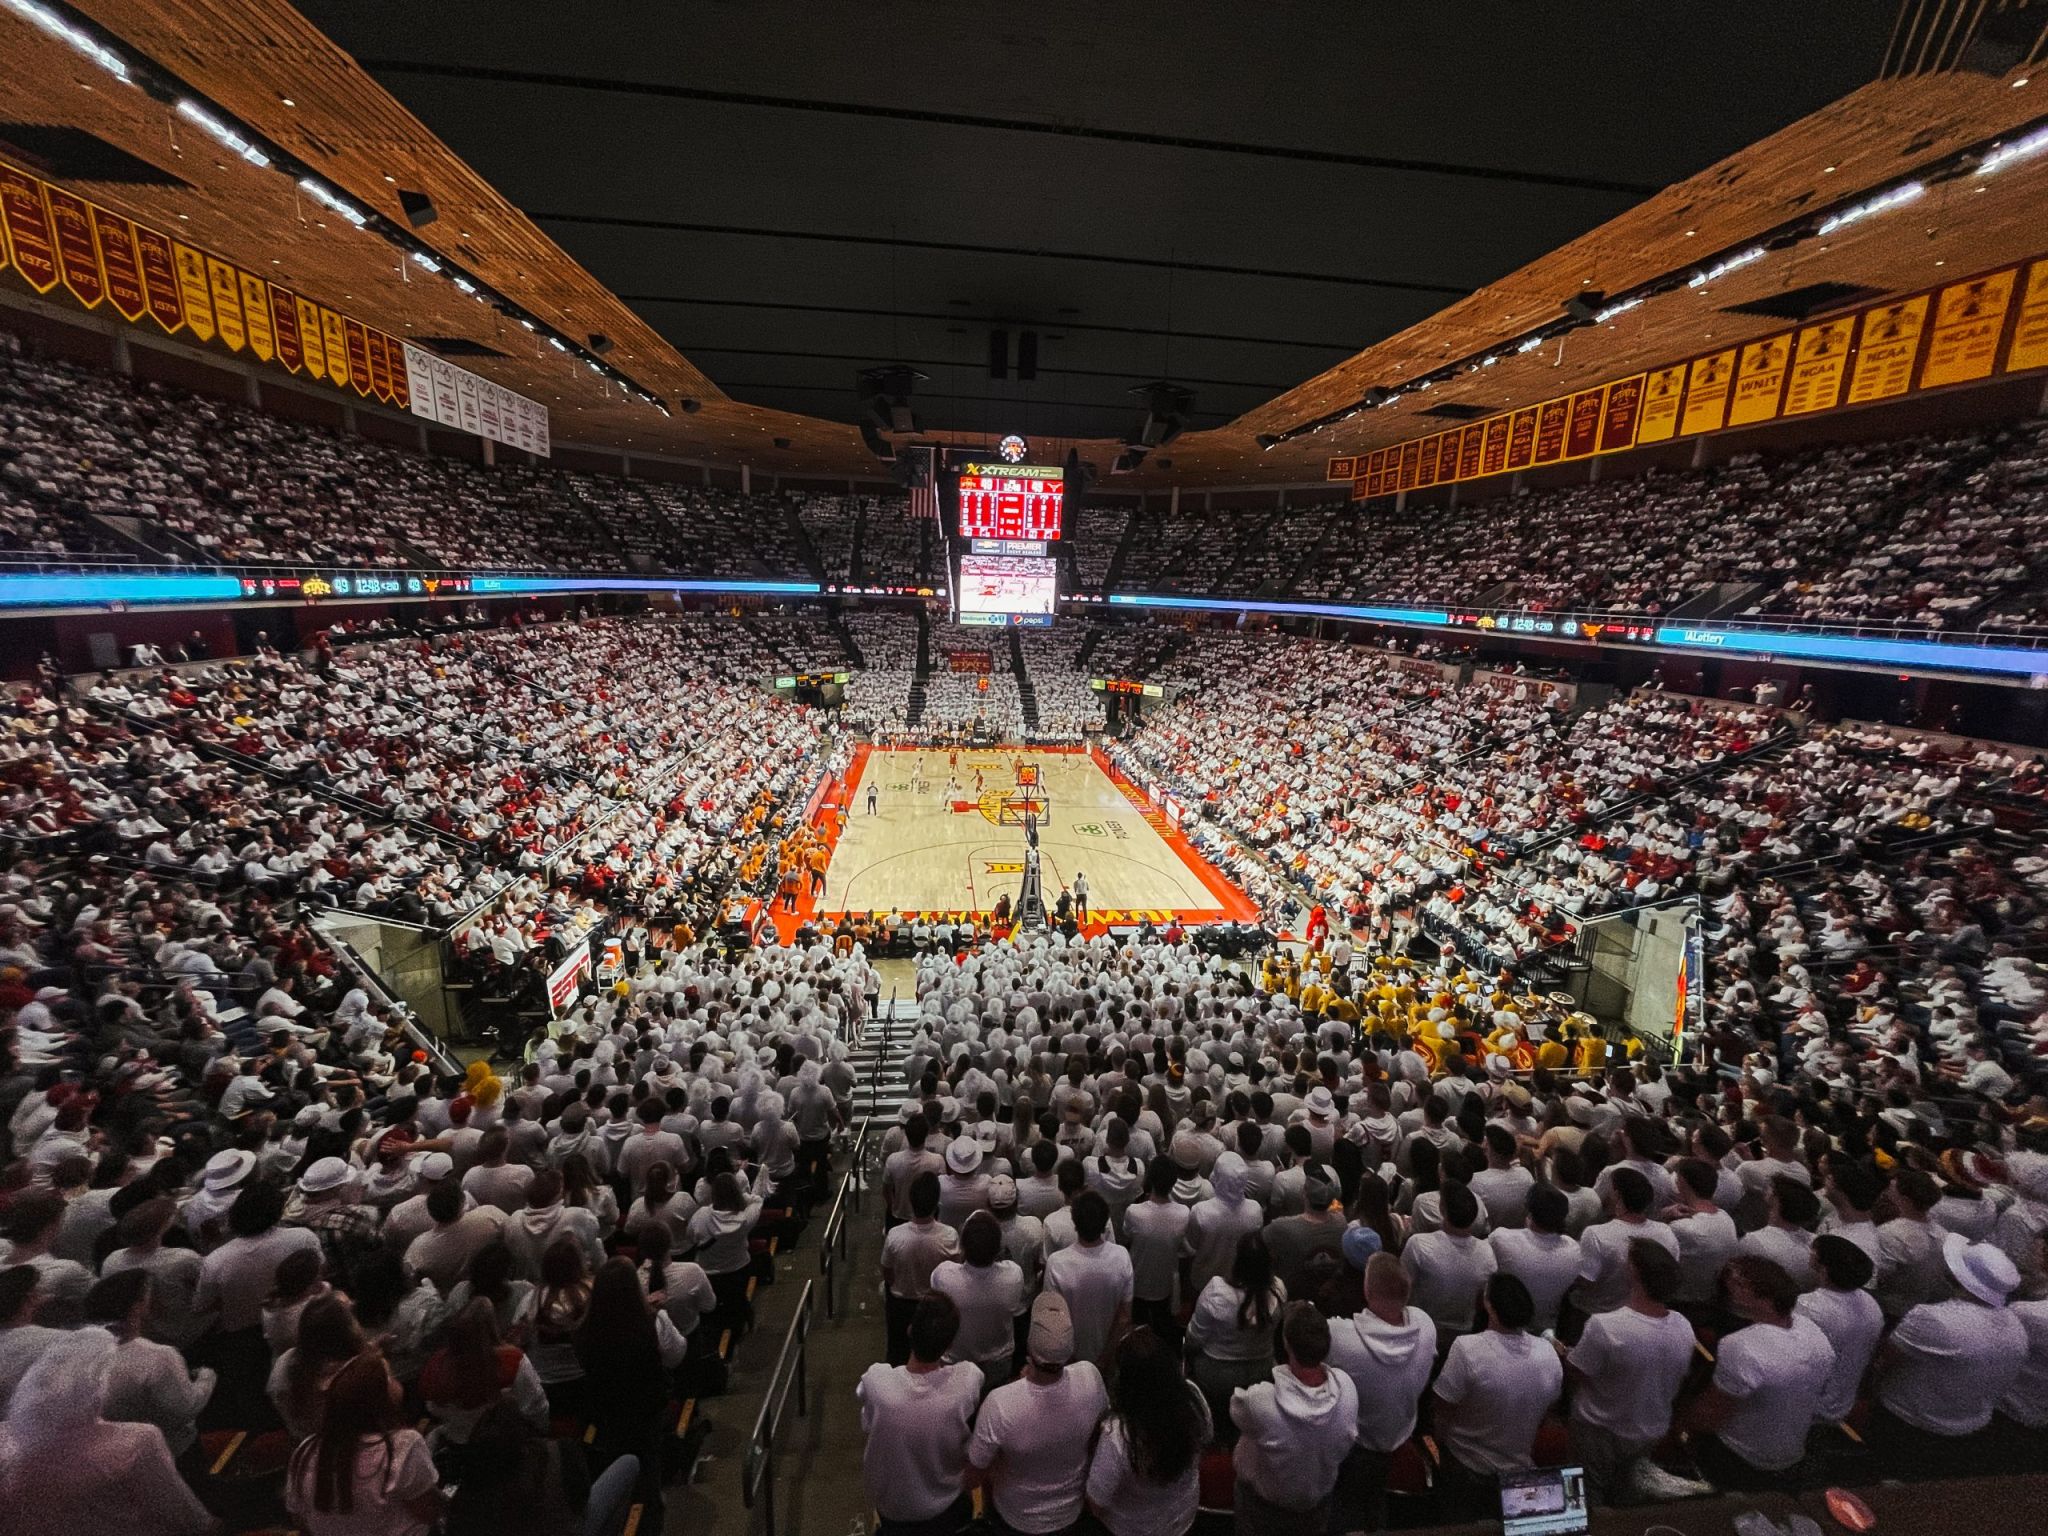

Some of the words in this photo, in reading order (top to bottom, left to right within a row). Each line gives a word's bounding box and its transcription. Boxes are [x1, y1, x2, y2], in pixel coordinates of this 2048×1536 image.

[1740, 374, 1780, 393] WNIT
[981, 465, 1039, 476] XTREAM
[1024, 617, 1044, 625] pepsi
